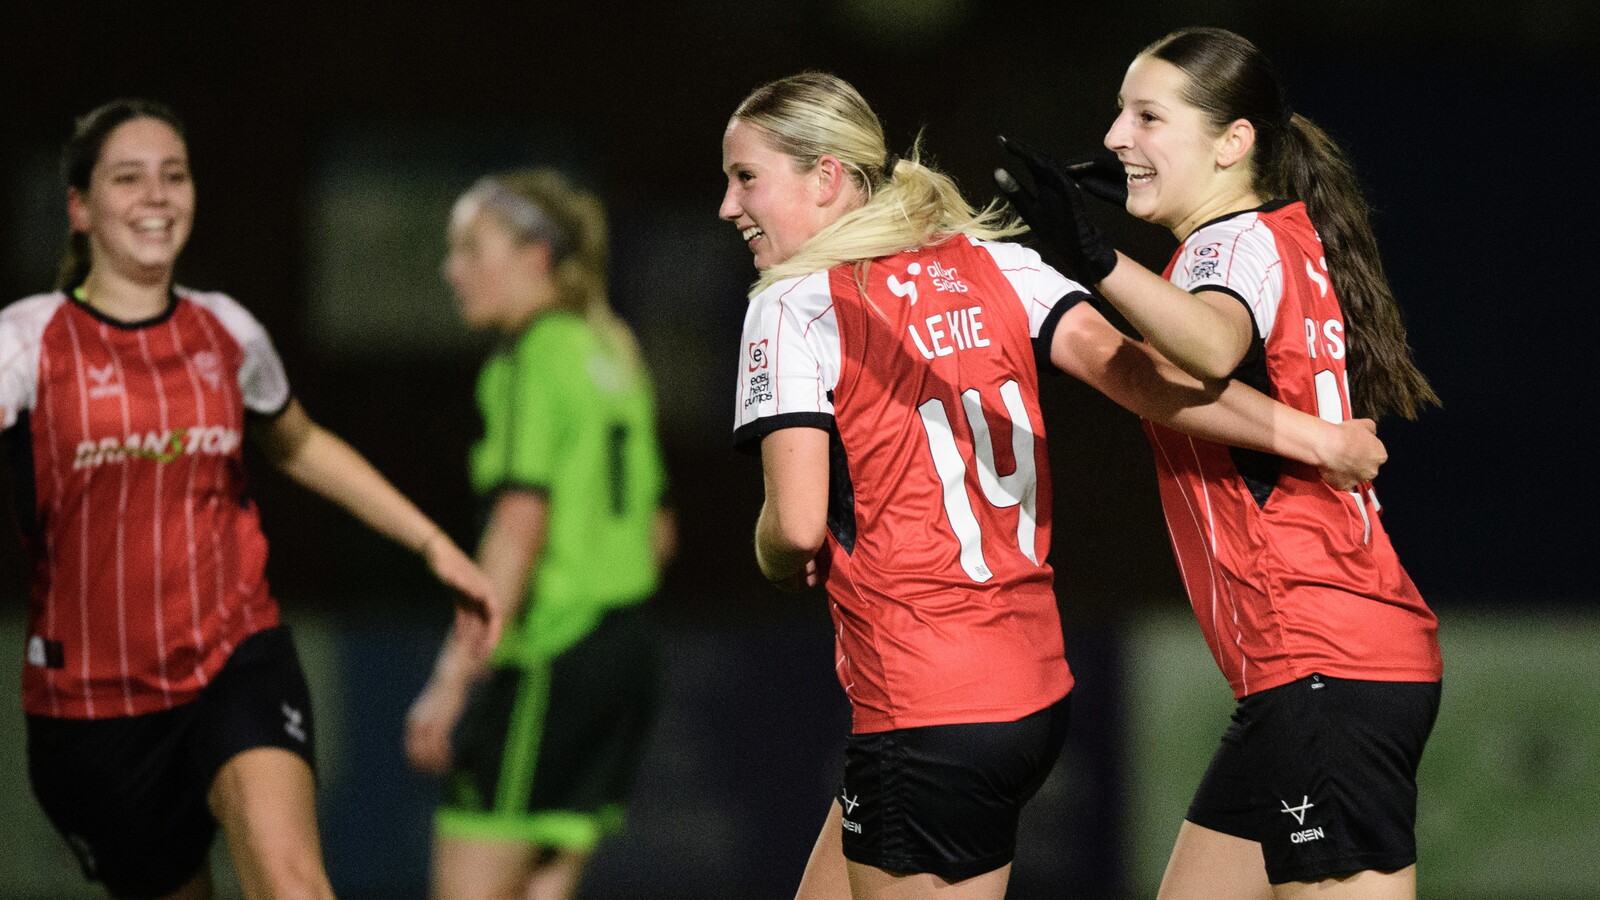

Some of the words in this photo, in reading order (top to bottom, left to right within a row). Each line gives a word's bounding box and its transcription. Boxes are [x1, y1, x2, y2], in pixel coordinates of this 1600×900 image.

[753, 348, 762, 362] e
[918, 379, 1040, 583] 14
[1290, 826, 1325, 844] OXEN
